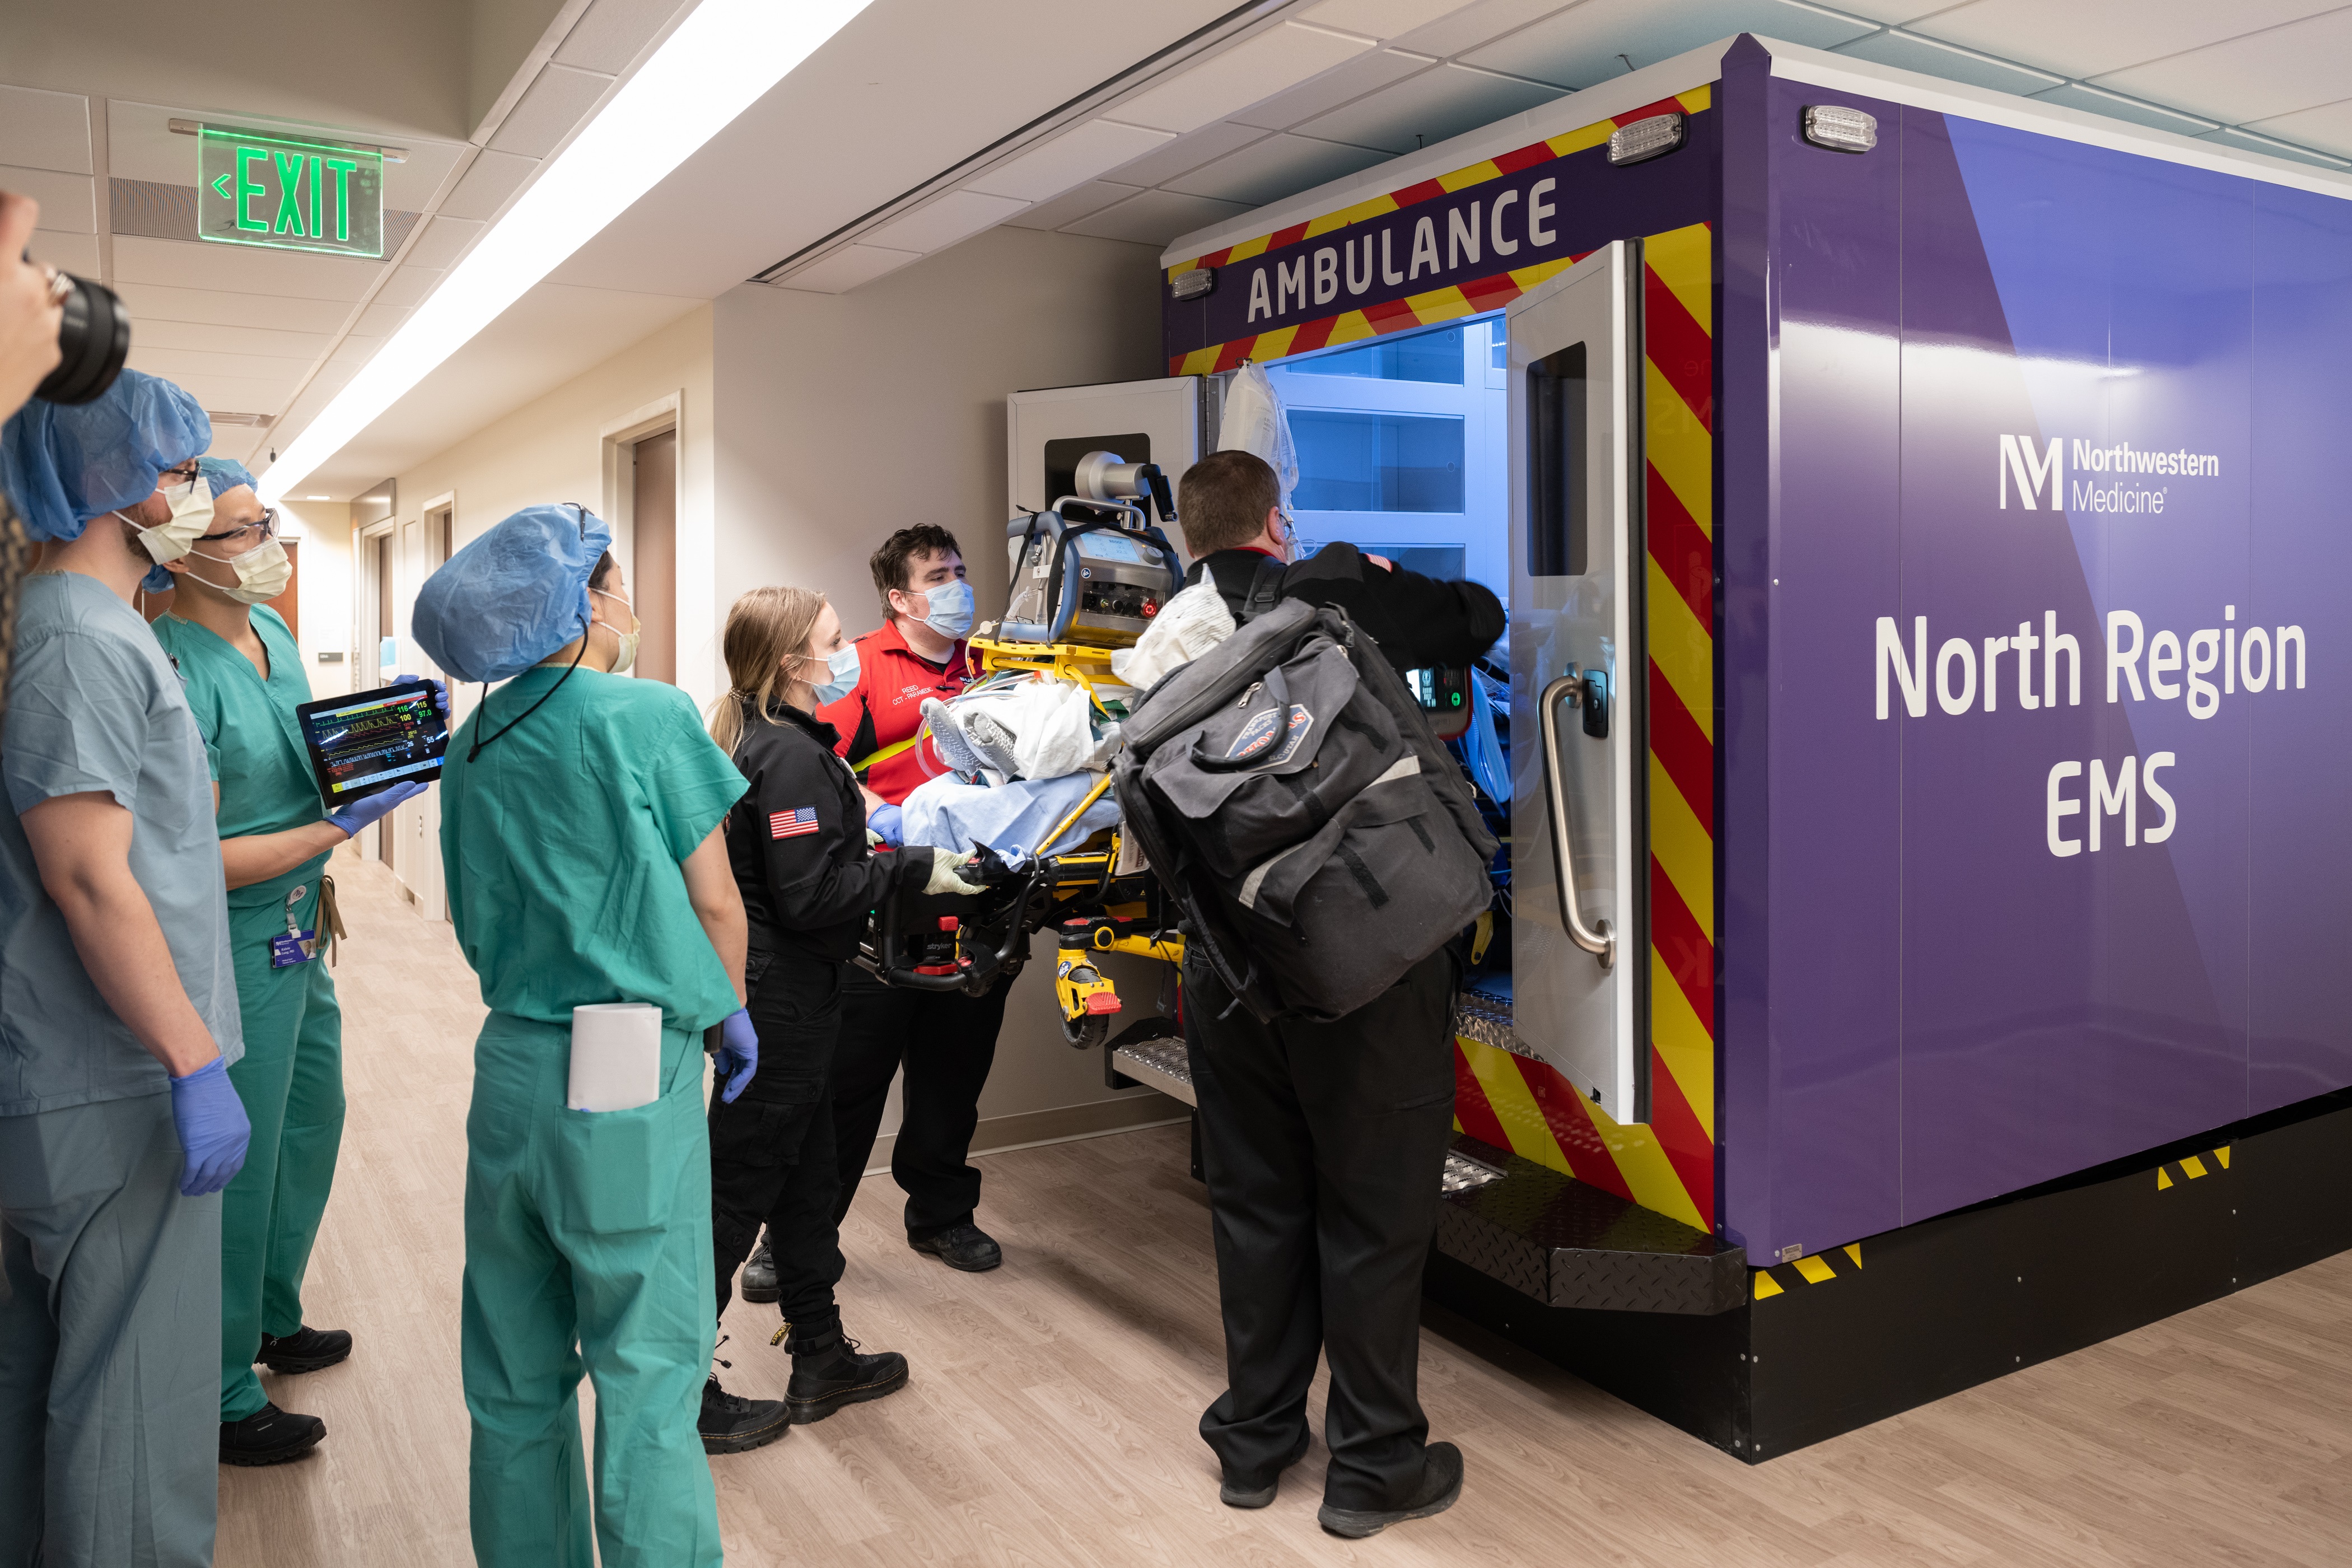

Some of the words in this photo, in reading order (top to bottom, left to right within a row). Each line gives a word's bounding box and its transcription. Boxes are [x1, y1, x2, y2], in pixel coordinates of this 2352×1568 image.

[236, 146, 357, 241] EXIT
[1247, 178, 1556, 323] AMBULANCE
[2073, 438, 2219, 477] Northwestern
[1876, 610, 2080, 720] North
[2107, 605, 2306, 720] Region
[892, 696, 904, 705] CCT
[907, 687, 934, 699] PARAMEDIC
[902, 685, 918, 694] REED
[418, 709, 432, 717] 97.0
[1242, 712, 1277, 740] TRANSPORT
[1251, 719, 1273, 736] PACKS
[1284, 735, 1299, 754] UTAH
[2047, 751, 2176, 857] EMS
